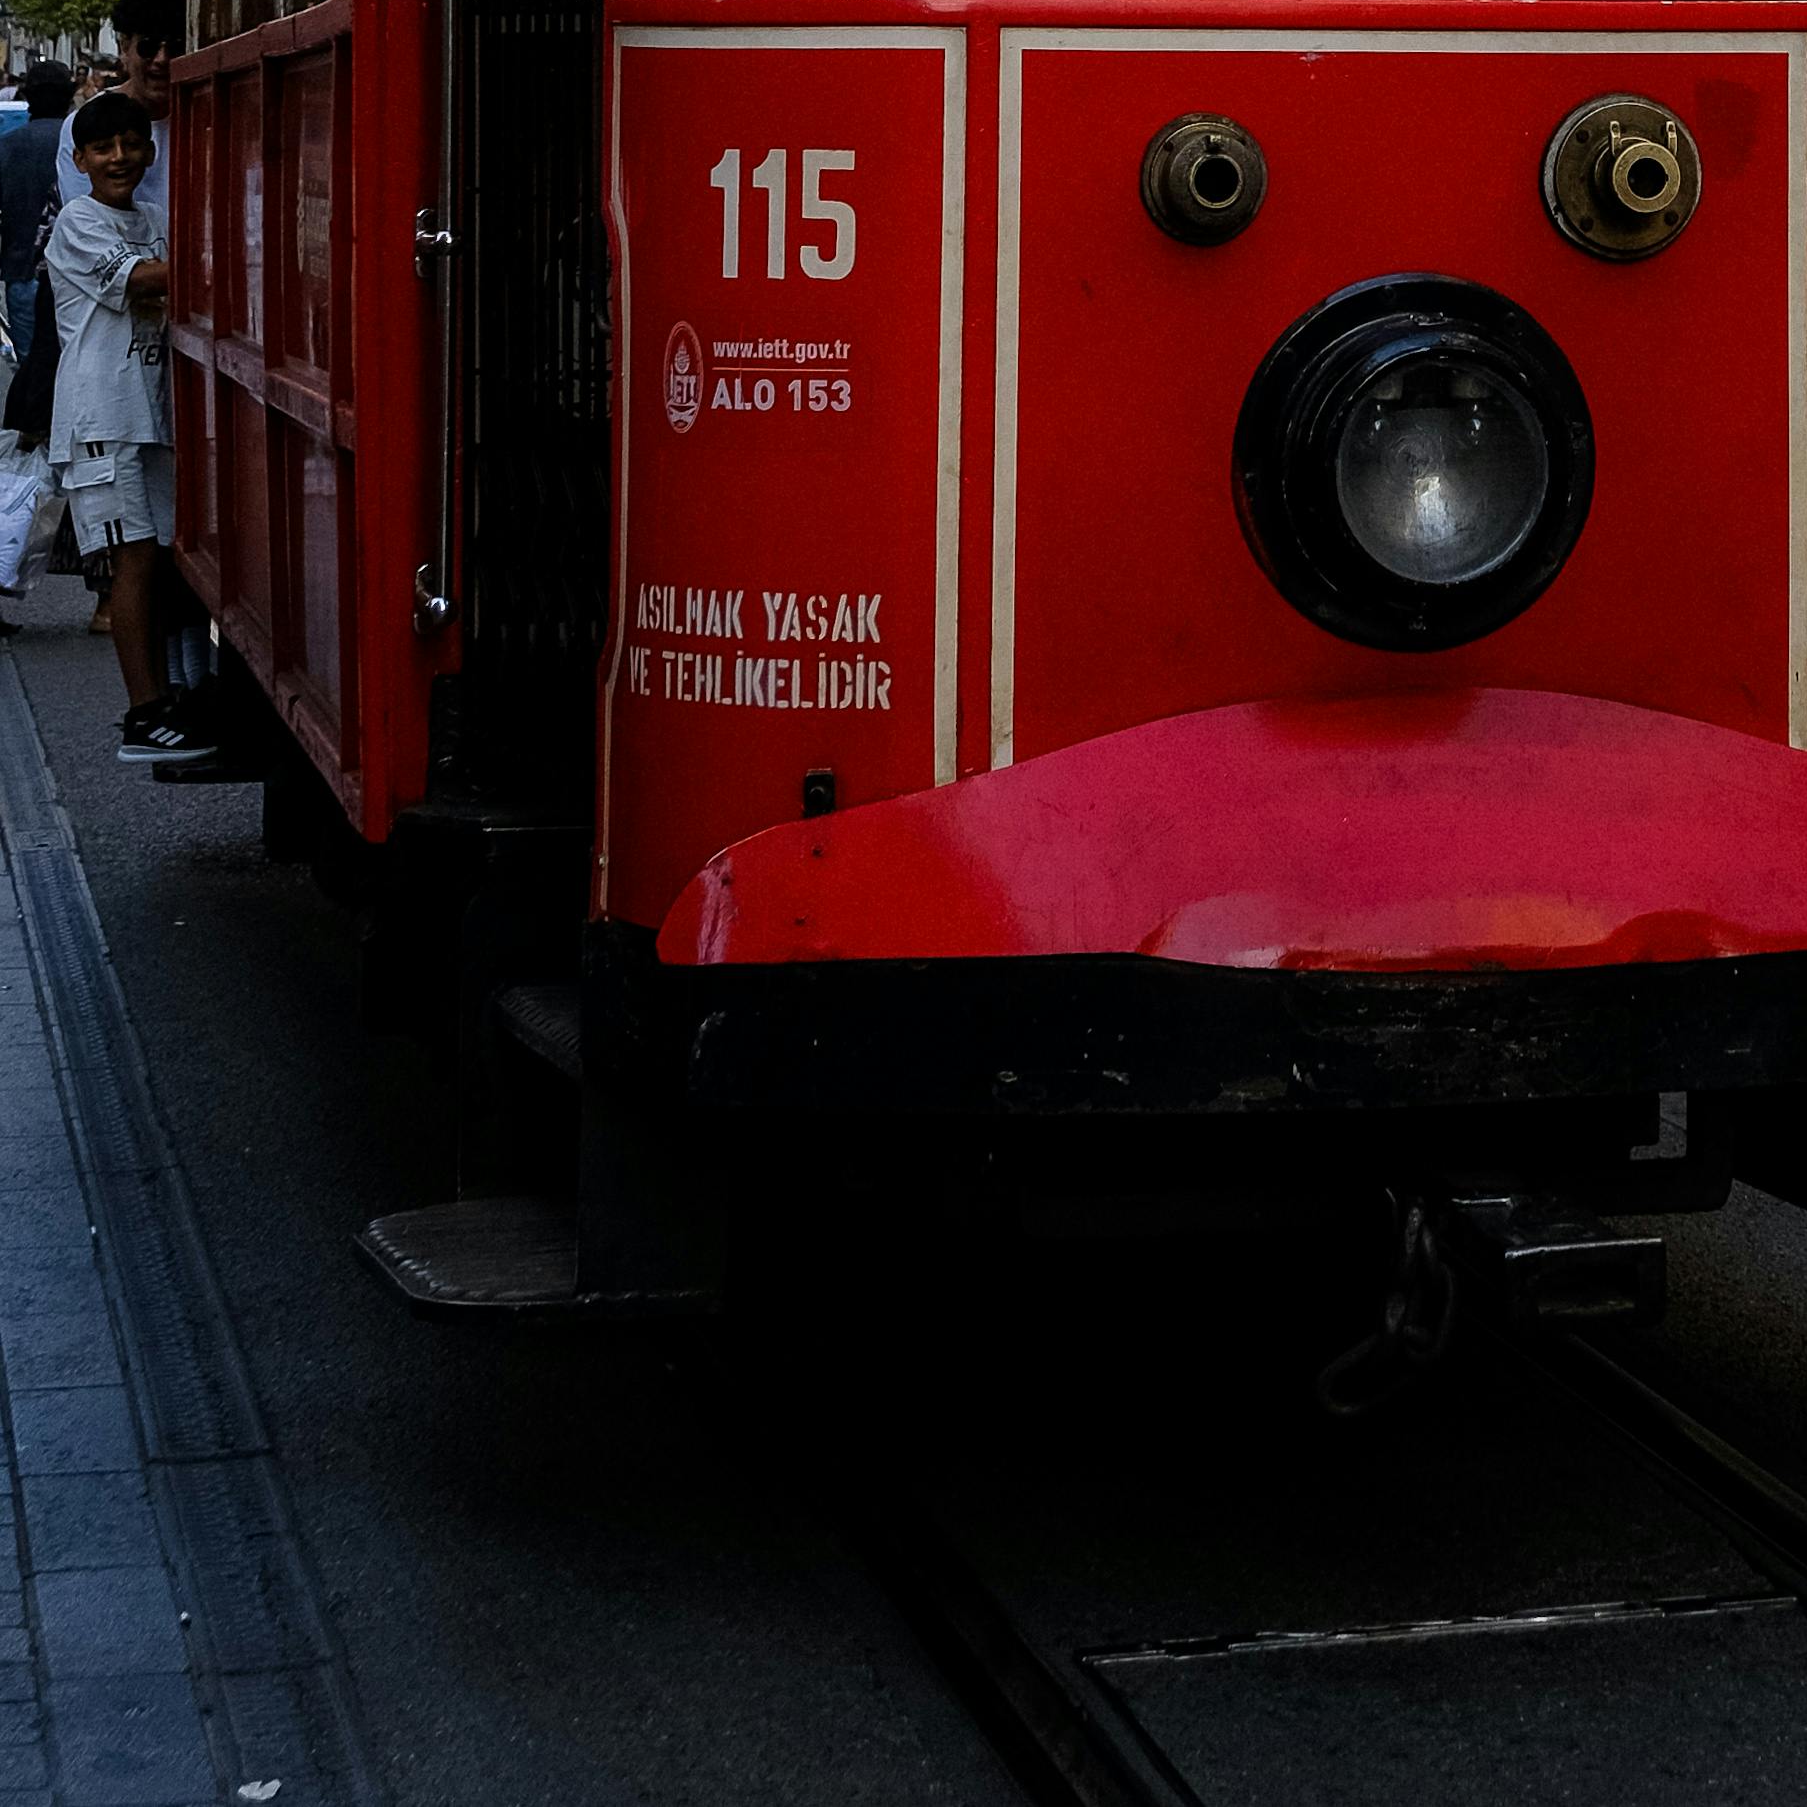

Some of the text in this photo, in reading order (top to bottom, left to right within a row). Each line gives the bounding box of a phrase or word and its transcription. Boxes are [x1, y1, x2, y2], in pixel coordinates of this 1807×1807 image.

[710, 149, 856, 280] 115
[712, 338, 851, 364] www.iett.gov.tr
[711, 377, 852, 412] ALO 153
[636, 582, 882, 644] ASILMAK YASAK
[629, 645, 892, 711] VE TEHLİKELİDİR
